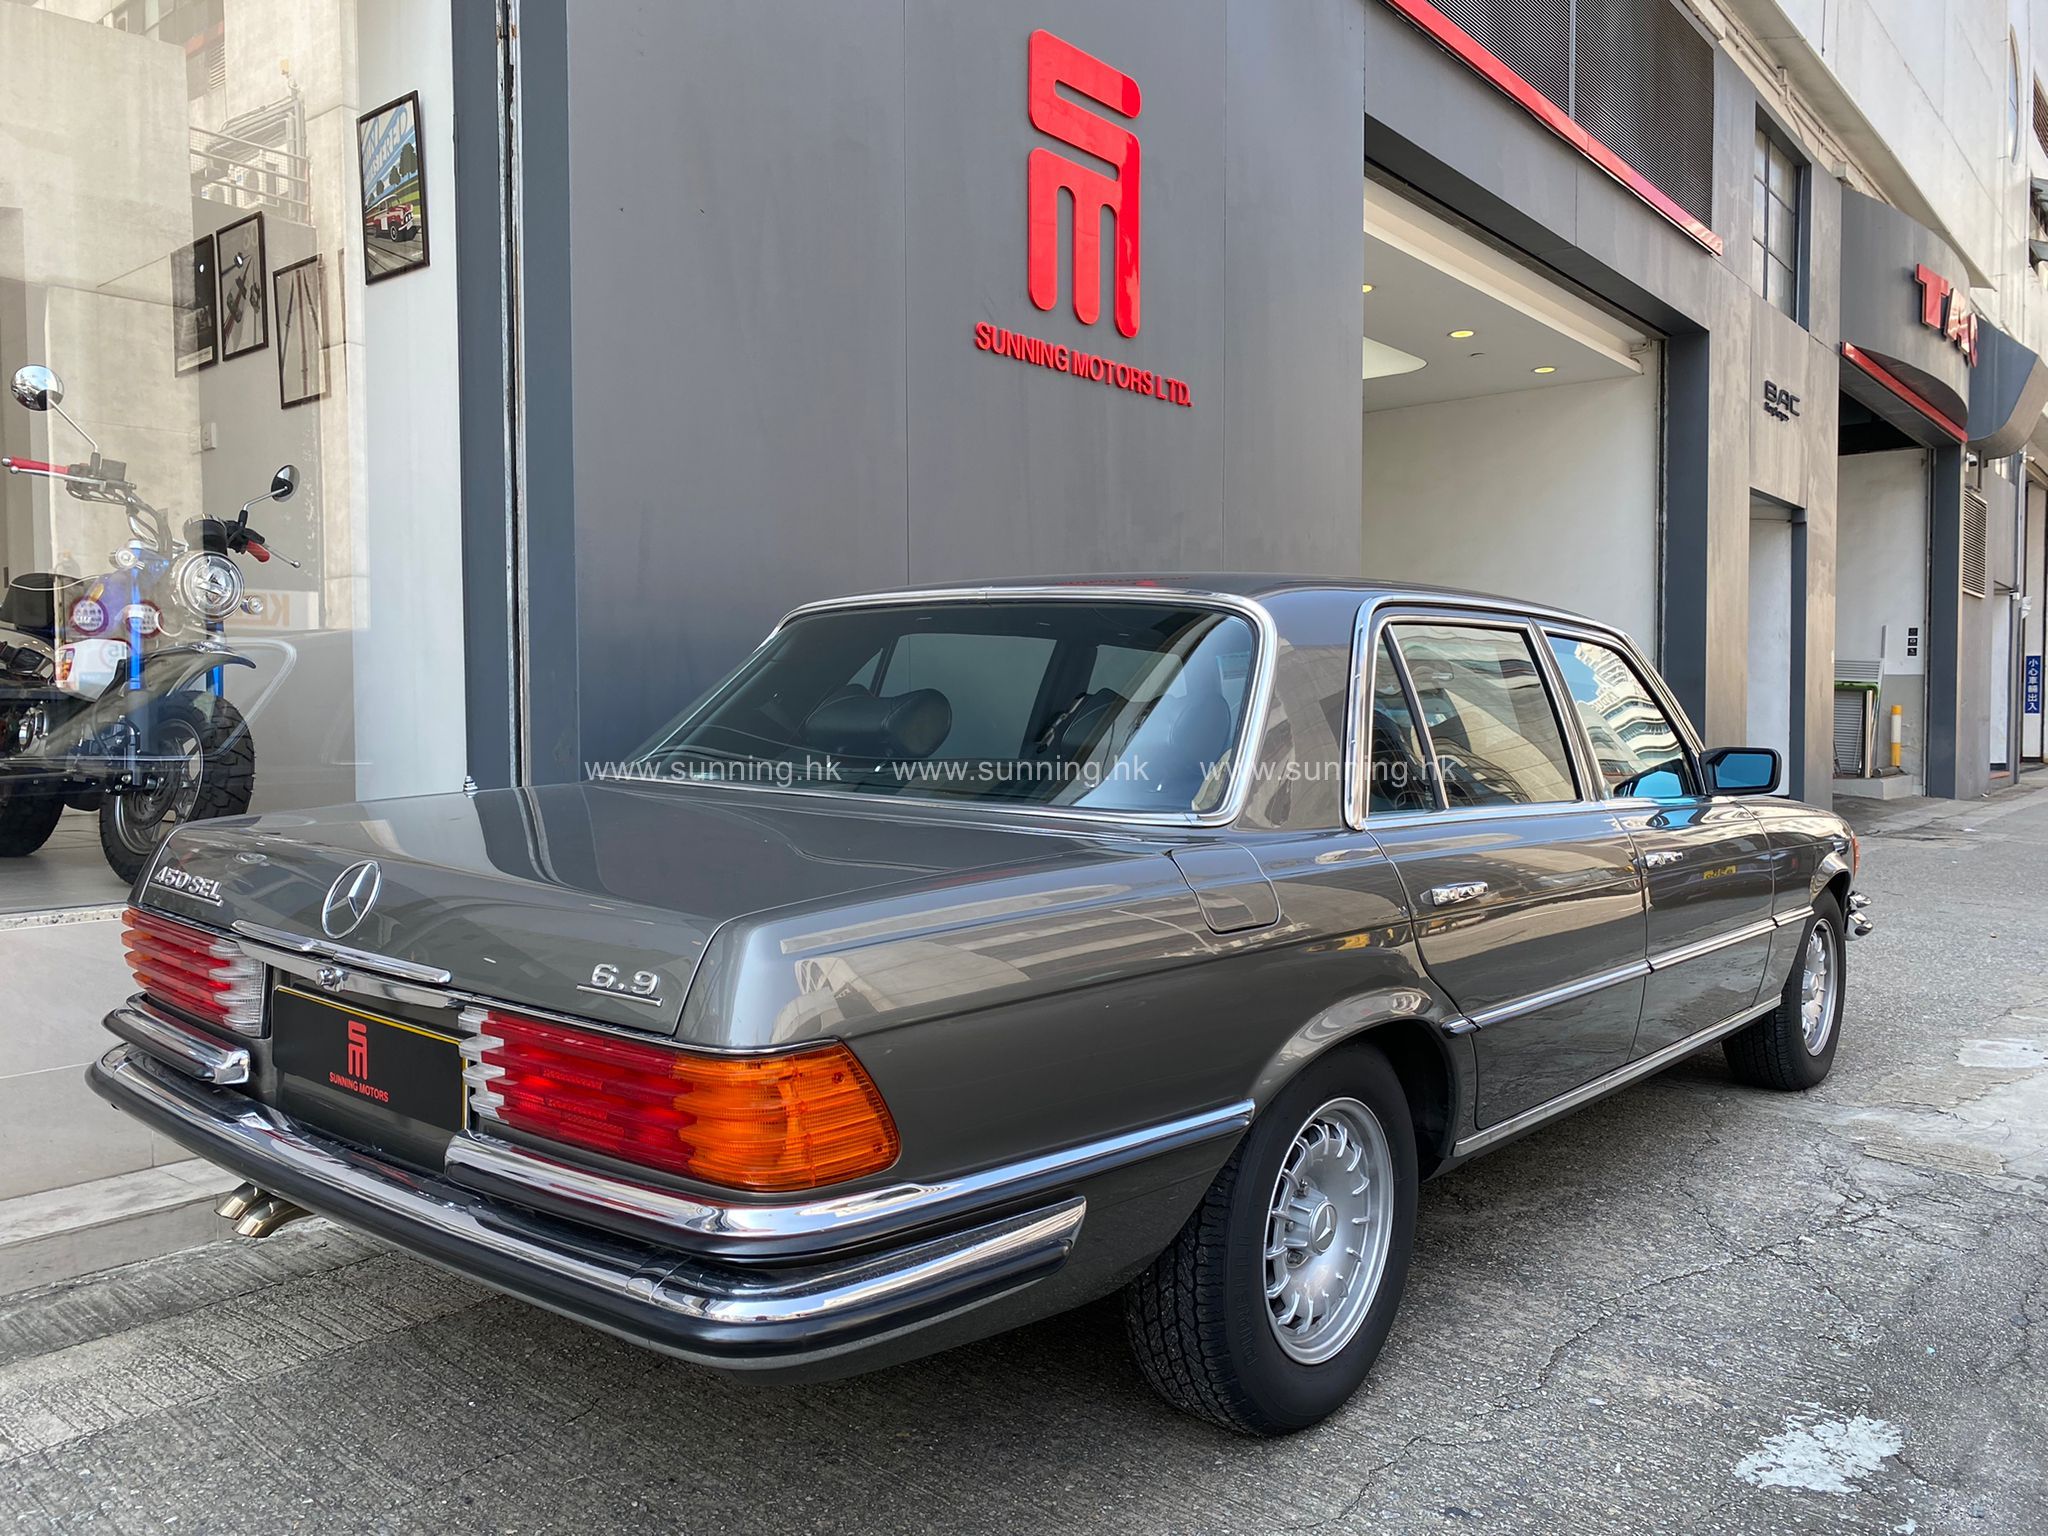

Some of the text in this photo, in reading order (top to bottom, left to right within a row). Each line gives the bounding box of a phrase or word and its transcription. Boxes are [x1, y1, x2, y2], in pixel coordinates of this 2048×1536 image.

[975, 321, 1193, 407] SUNNING MOTORS LTD.
[1764, 380, 1800, 417] BAC
[2027, 658, 2039, 711] 小心車輛出入
[591, 963, 660, 996] 6.9
[329, 1071, 389, 1103] SUNNING MOTORS
